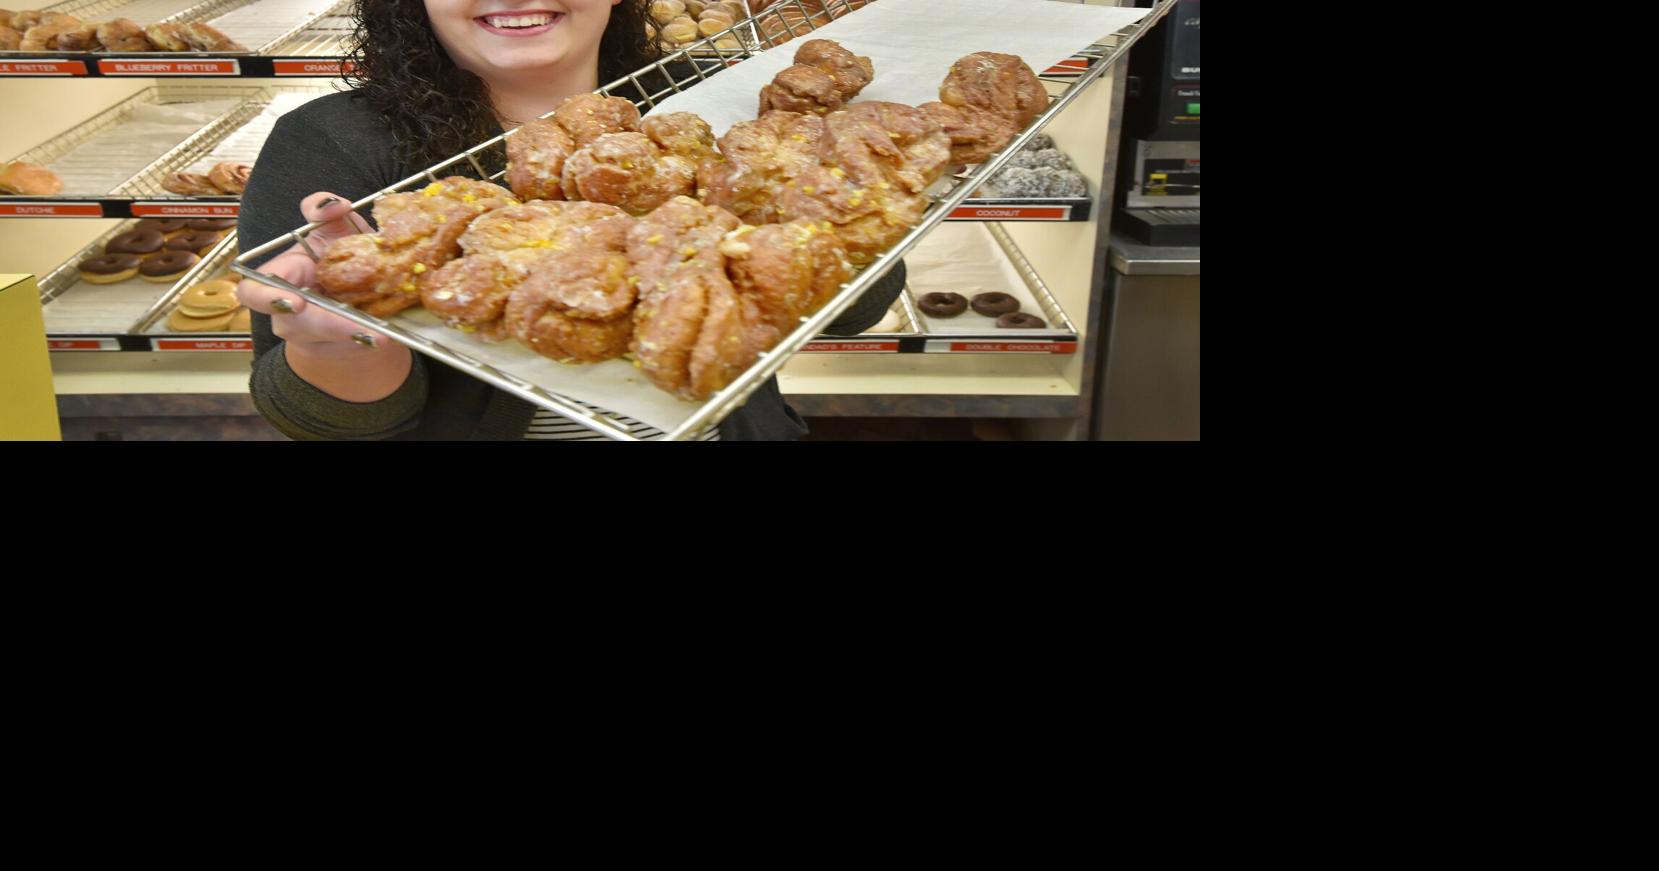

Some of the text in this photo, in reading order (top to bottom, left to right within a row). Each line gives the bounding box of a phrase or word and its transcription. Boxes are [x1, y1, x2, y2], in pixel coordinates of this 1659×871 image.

[14, 64, 58, 72] FRITTER
[114, 63, 219, 72] BLUEBERRY FRITTER
[303, 64, 341, 72] ORANGE
[16, 206, 56, 214] DUTCHIE
[975, 209, 1021, 217] COCONUT
[964, 343, 1060, 351] DOUBLE CHOCOLATE
